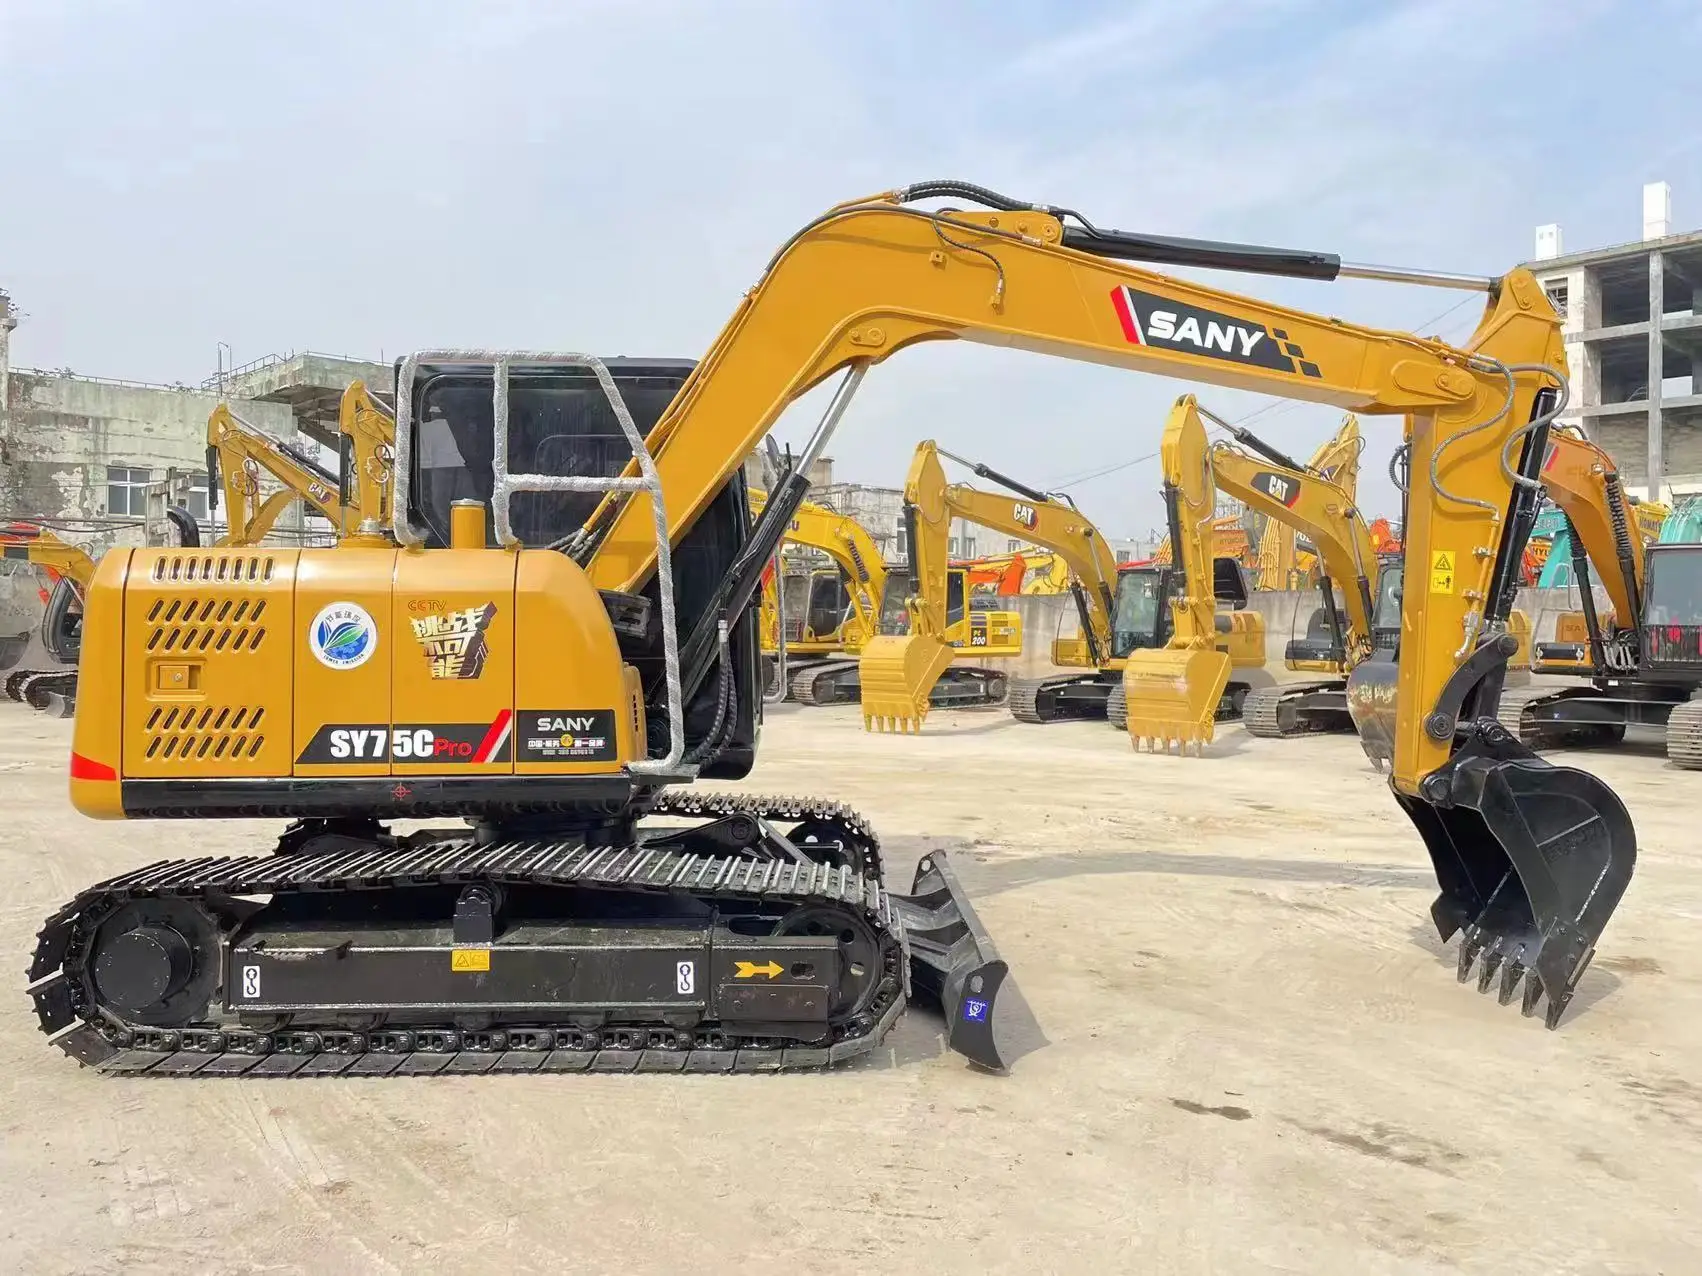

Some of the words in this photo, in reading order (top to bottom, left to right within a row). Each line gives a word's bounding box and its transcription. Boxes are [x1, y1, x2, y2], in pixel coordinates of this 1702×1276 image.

[1147, 310, 1264, 356] SANY
[309, 482, 326, 500] CAT
[1269, 475, 1288, 501] CAT
[1014, 503, 1034, 526] CAT
[407, 600, 447, 612] CCTV
[971, 637, 986, 646] 200
[537, 717, 595, 731] SANY
[330, 729, 435, 758] SY75C
[434, 737, 472, 757] Pro
